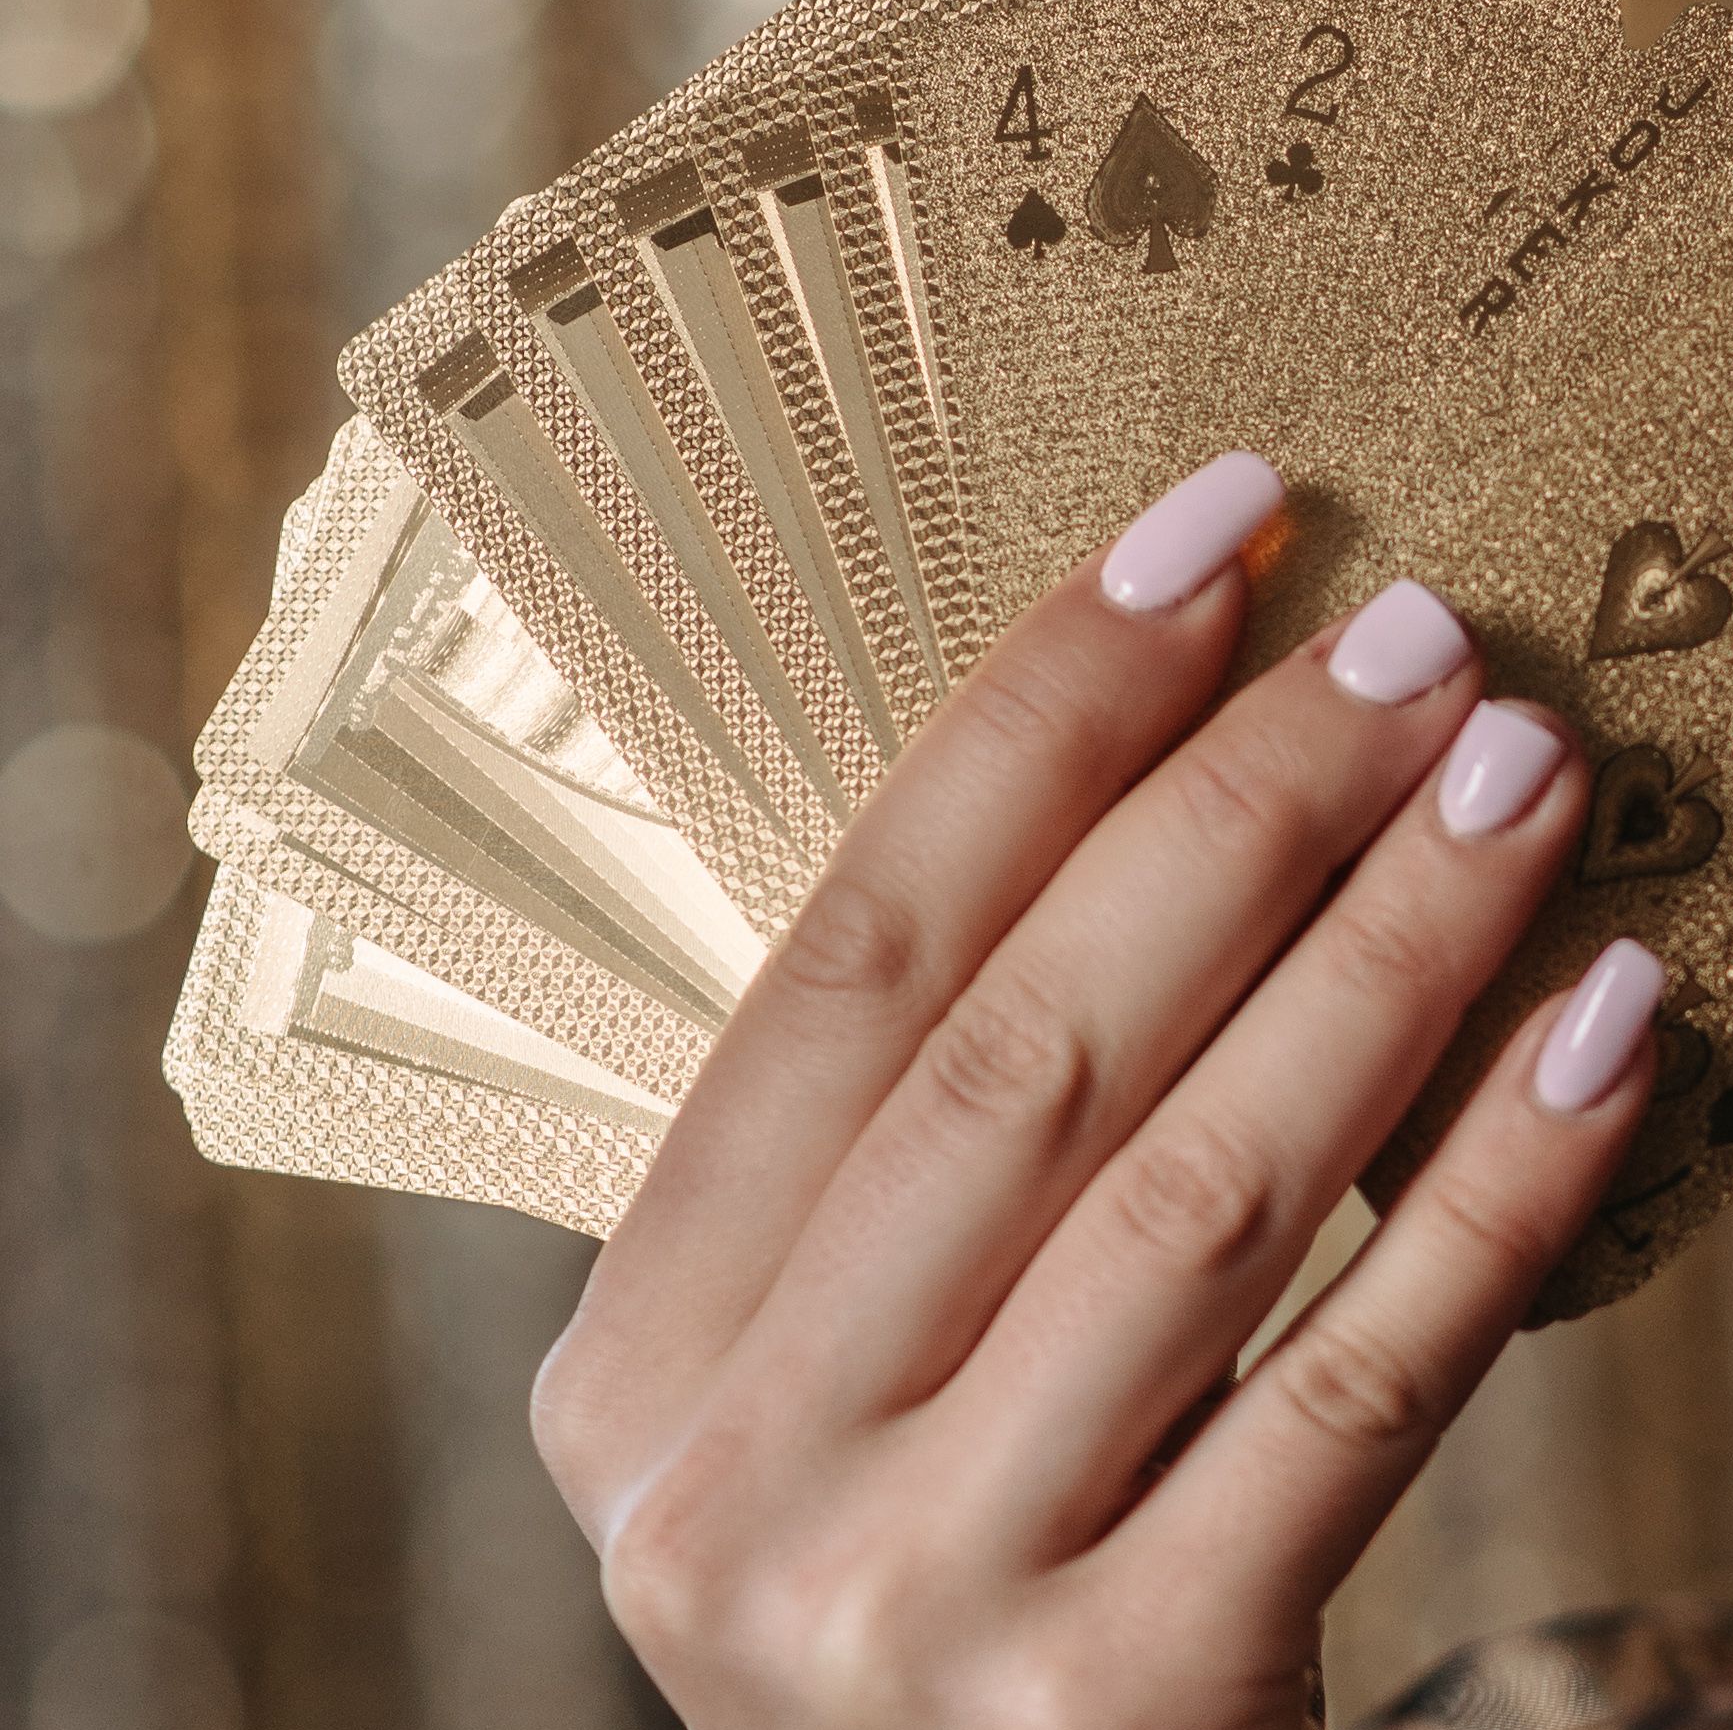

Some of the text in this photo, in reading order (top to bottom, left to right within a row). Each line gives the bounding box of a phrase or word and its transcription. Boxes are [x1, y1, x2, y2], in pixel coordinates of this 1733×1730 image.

[995, 69, 1053, 161] 4
[1286, 25, 1355, 126] 2
[1459, 76, 1714, 337] JOKER
